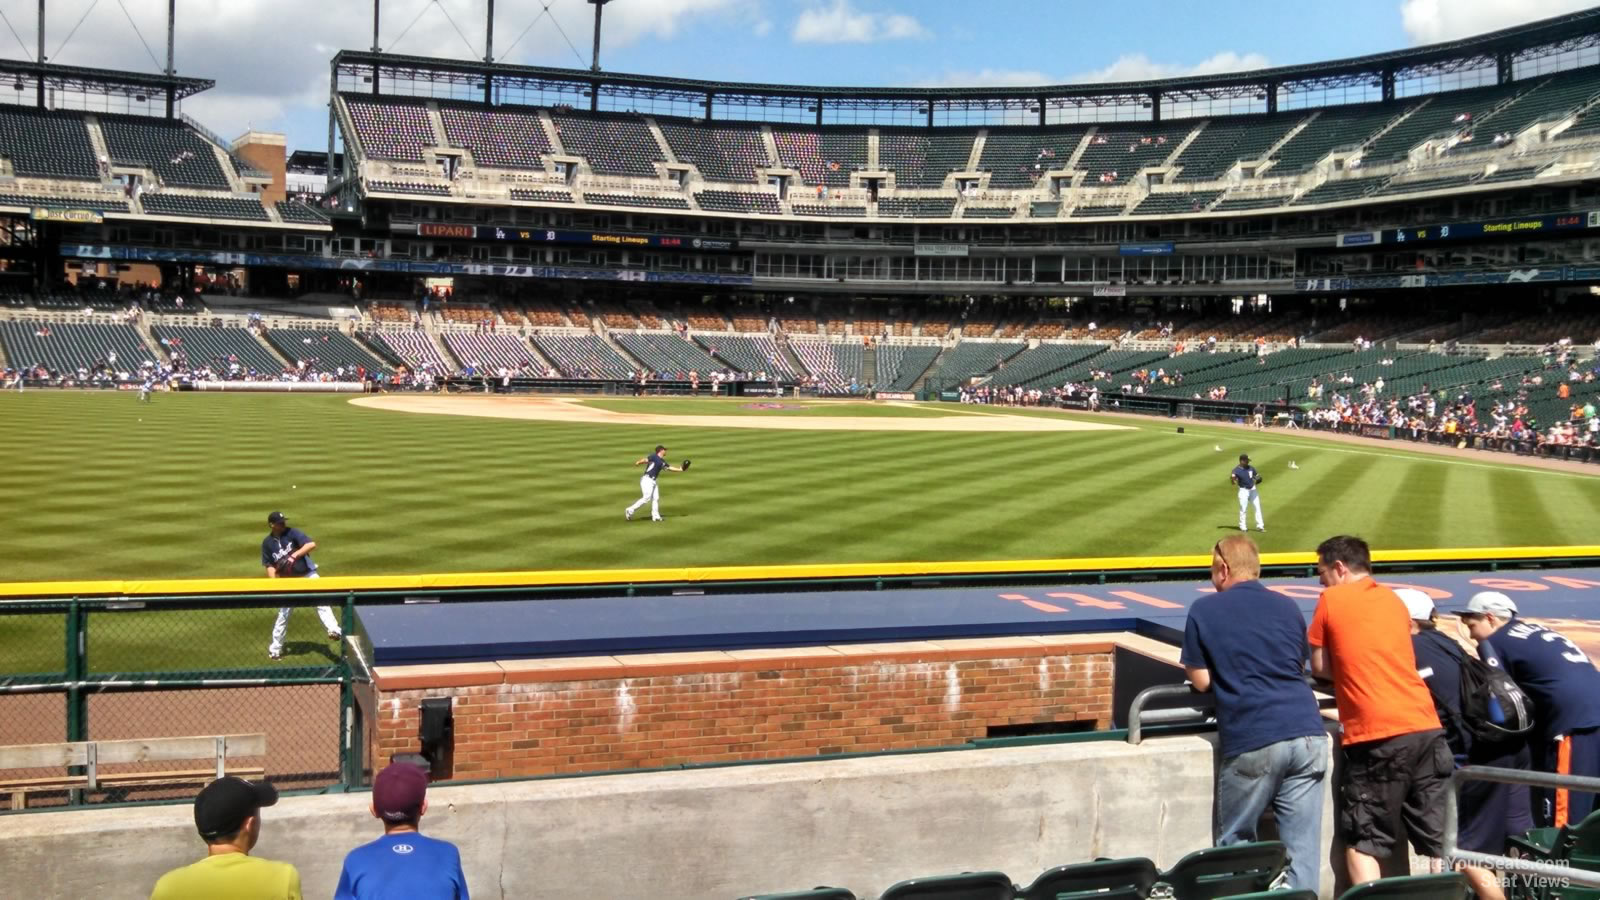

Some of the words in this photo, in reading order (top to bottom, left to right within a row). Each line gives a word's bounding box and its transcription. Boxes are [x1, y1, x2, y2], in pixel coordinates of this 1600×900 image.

[425, 225, 468, 237] LIPARI
[1483, 222, 1512, 233] Starting
[1513, 220, 1542, 231] Lineups
[592, 234, 620, 244] Starting
[622, 236, 648, 245] Lineups
[1541, 632, 1590, 663] 3
